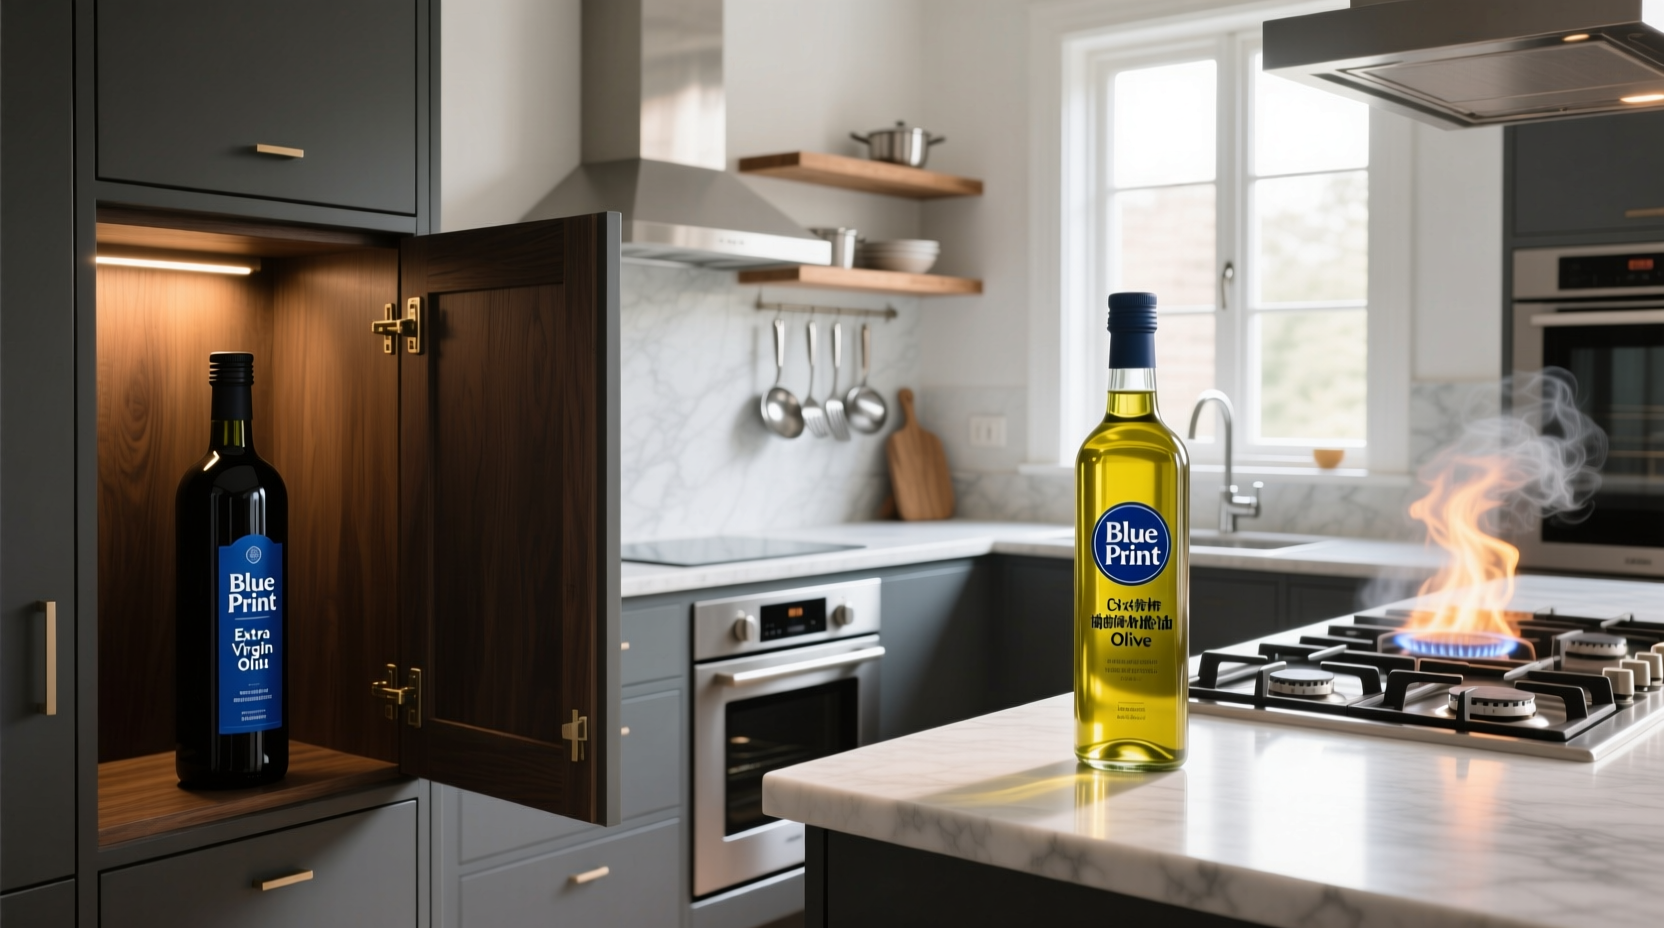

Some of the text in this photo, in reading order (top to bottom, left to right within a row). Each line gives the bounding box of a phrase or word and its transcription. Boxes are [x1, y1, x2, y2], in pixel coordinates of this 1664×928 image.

[1106, 520, 1158, 543] Blue
[1105, 544, 1161, 566] Print
[229, 572, 275, 593] Blue
[228, 592, 277, 614] Print
[234, 627, 270, 641] Extra
[1110, 631, 1152, 647] Olive
